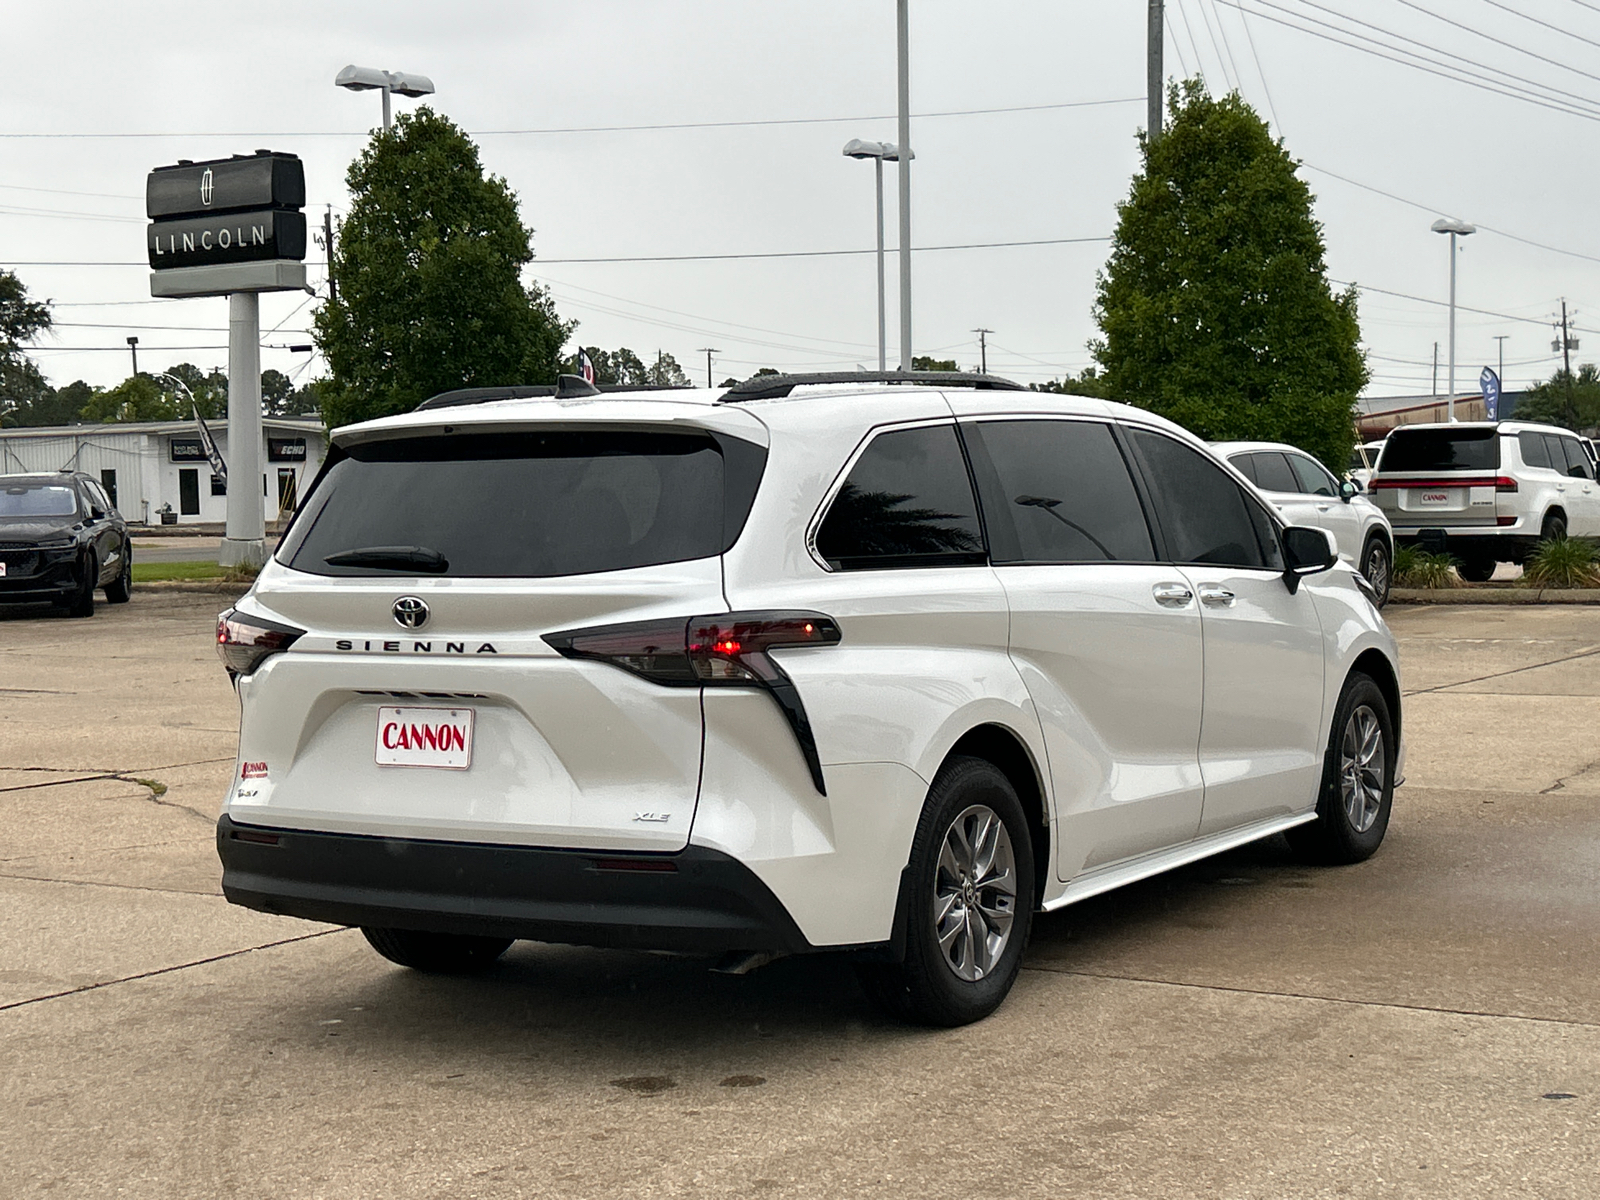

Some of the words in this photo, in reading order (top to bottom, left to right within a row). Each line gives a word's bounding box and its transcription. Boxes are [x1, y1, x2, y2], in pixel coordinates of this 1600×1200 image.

[155, 225, 265, 255] LINCOLN
[281, 445, 305, 455] ECHO
[336, 640, 498, 653] SIENNA
[382, 722, 466, 752] CANNON
[632, 811, 671, 823] XLE
